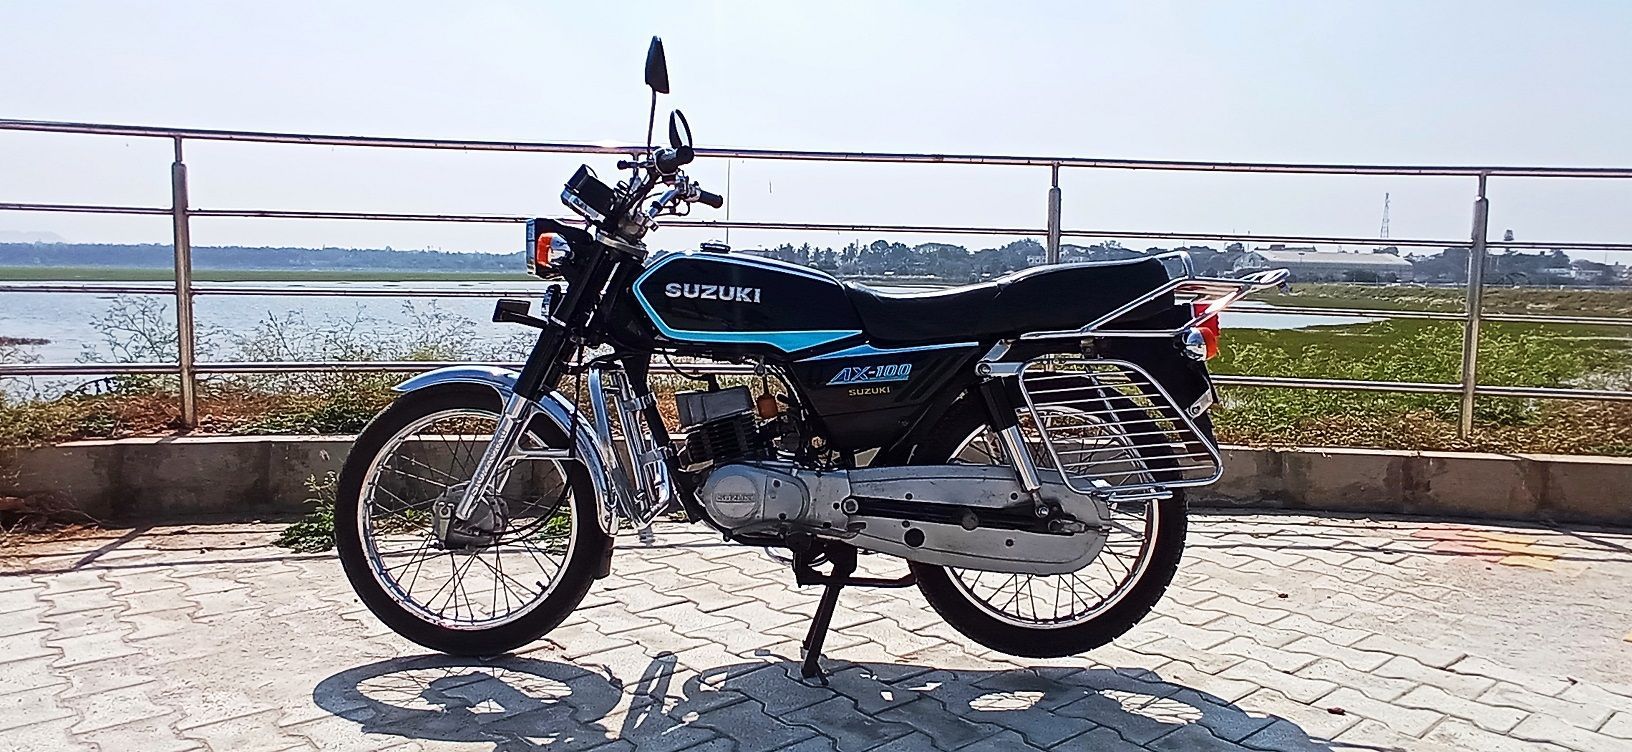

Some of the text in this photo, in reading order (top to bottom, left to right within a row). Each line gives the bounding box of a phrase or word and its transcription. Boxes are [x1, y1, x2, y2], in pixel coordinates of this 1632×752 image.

[665, 282, 761, 303] SUZUKI
[828, 363, 912, 383] AX-100
[848, 386, 891, 396] SUZUKI
